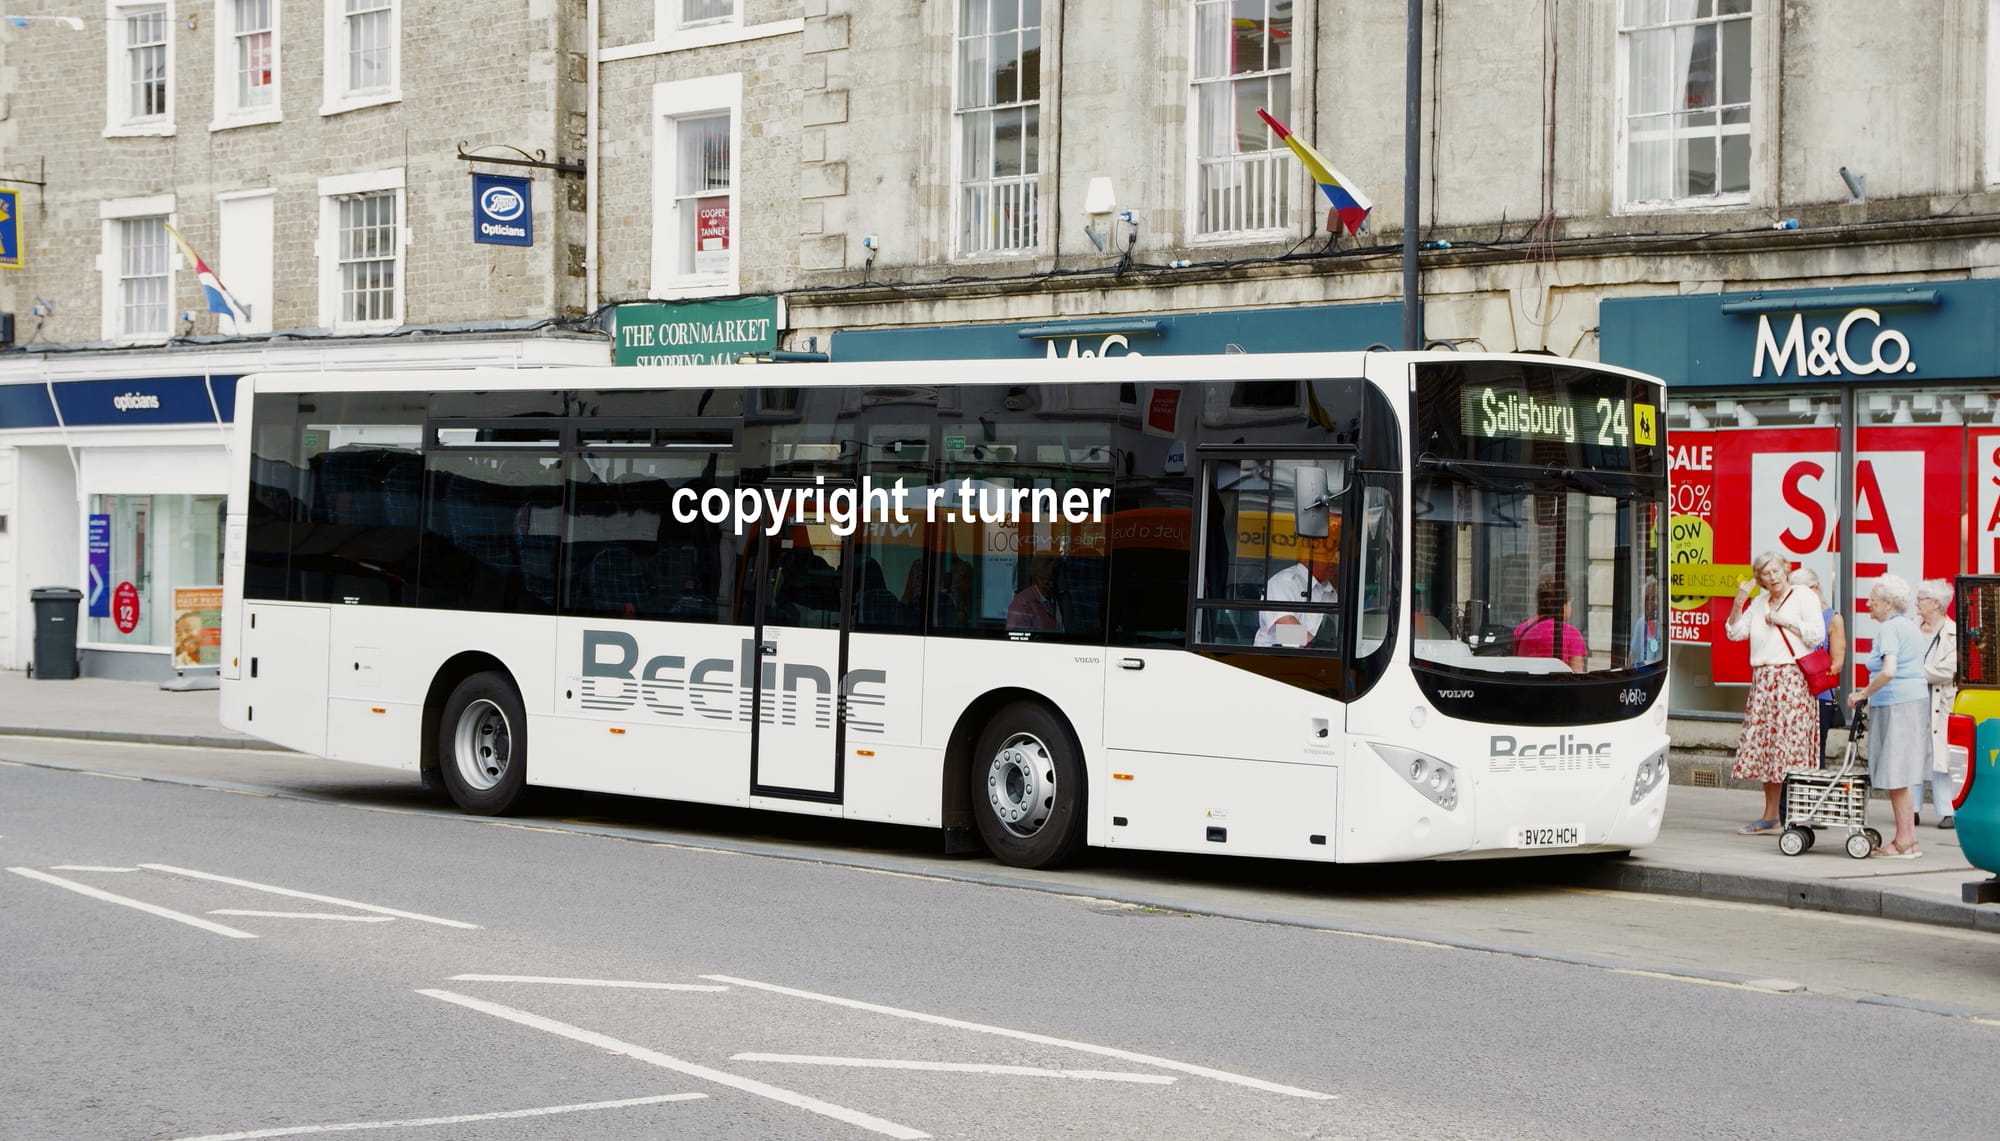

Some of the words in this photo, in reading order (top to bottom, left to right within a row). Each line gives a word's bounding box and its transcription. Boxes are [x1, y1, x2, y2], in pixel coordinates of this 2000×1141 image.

[701, 208, 726, 218] COOPER
[481, 223, 526, 237] Opticians
[701, 226, 726, 236] TANNER
[622, 324, 655, 347] THE
[658, 318, 770, 346] CORNMARKET
[1752, 308, 1917, 378] M&Co.
[113, 392, 160, 412] opticians
[1482, 387, 1575, 443] Salisbury
[1596, 398, 1629, 447] 24
[1670, 521, 1702, 542] OW
[1687, 574, 1716, 588] LINES
[119, 605, 134, 620] 1/2
[1670, 611, 1710, 625] LECTED
[1670, 626, 1700, 640] TEMS
[1074, 656, 1100, 664] VOLVO
[1438, 689, 1475, 698] VOLVO
[1525, 829, 1554, 845] BV22
[1556, 827, 1578, 844] HCH
